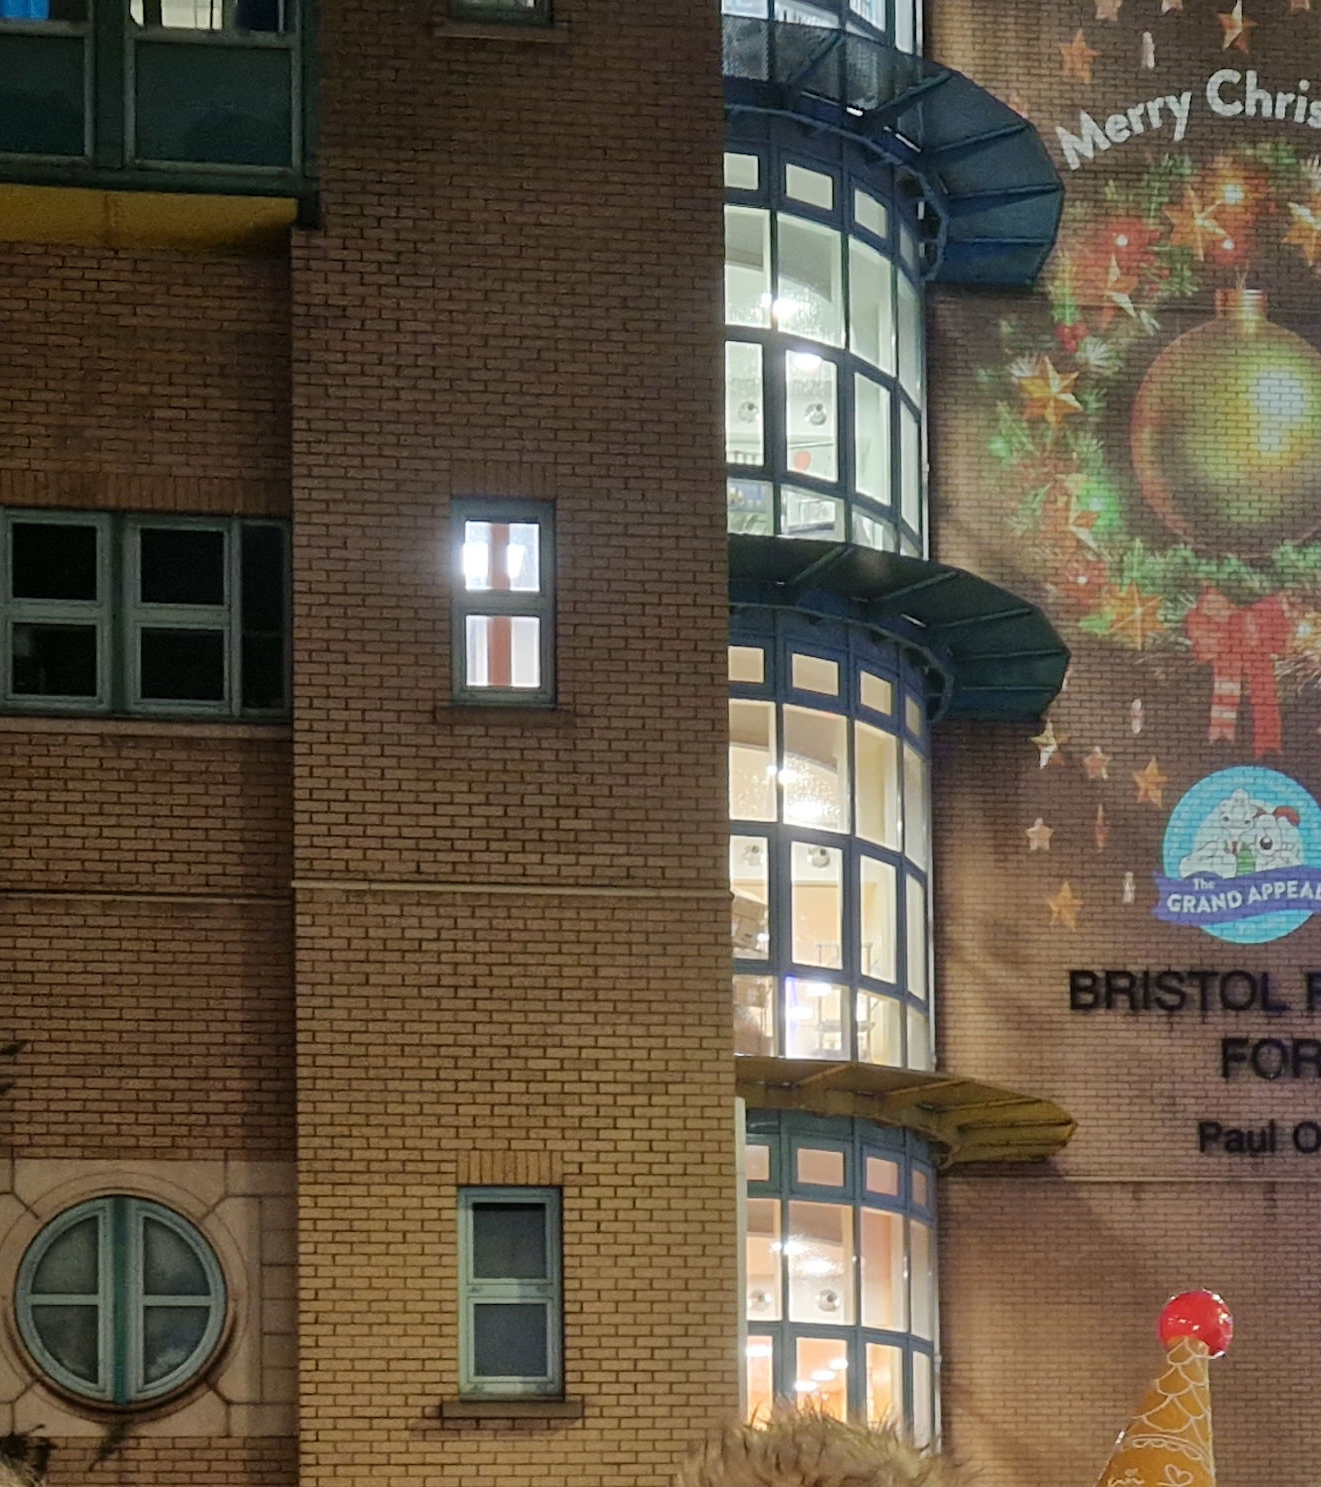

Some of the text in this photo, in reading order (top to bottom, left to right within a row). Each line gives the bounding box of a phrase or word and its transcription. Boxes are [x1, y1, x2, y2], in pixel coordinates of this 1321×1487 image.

[1055, 91, 1192, 171] Merry
[1193, 877, 1215, 891] The
[1166, 891, 1243, 914] GRAND
[1069, 969, 1291, 1014] BRISTOL
[1198, 1119, 1275, 1153] Paul
